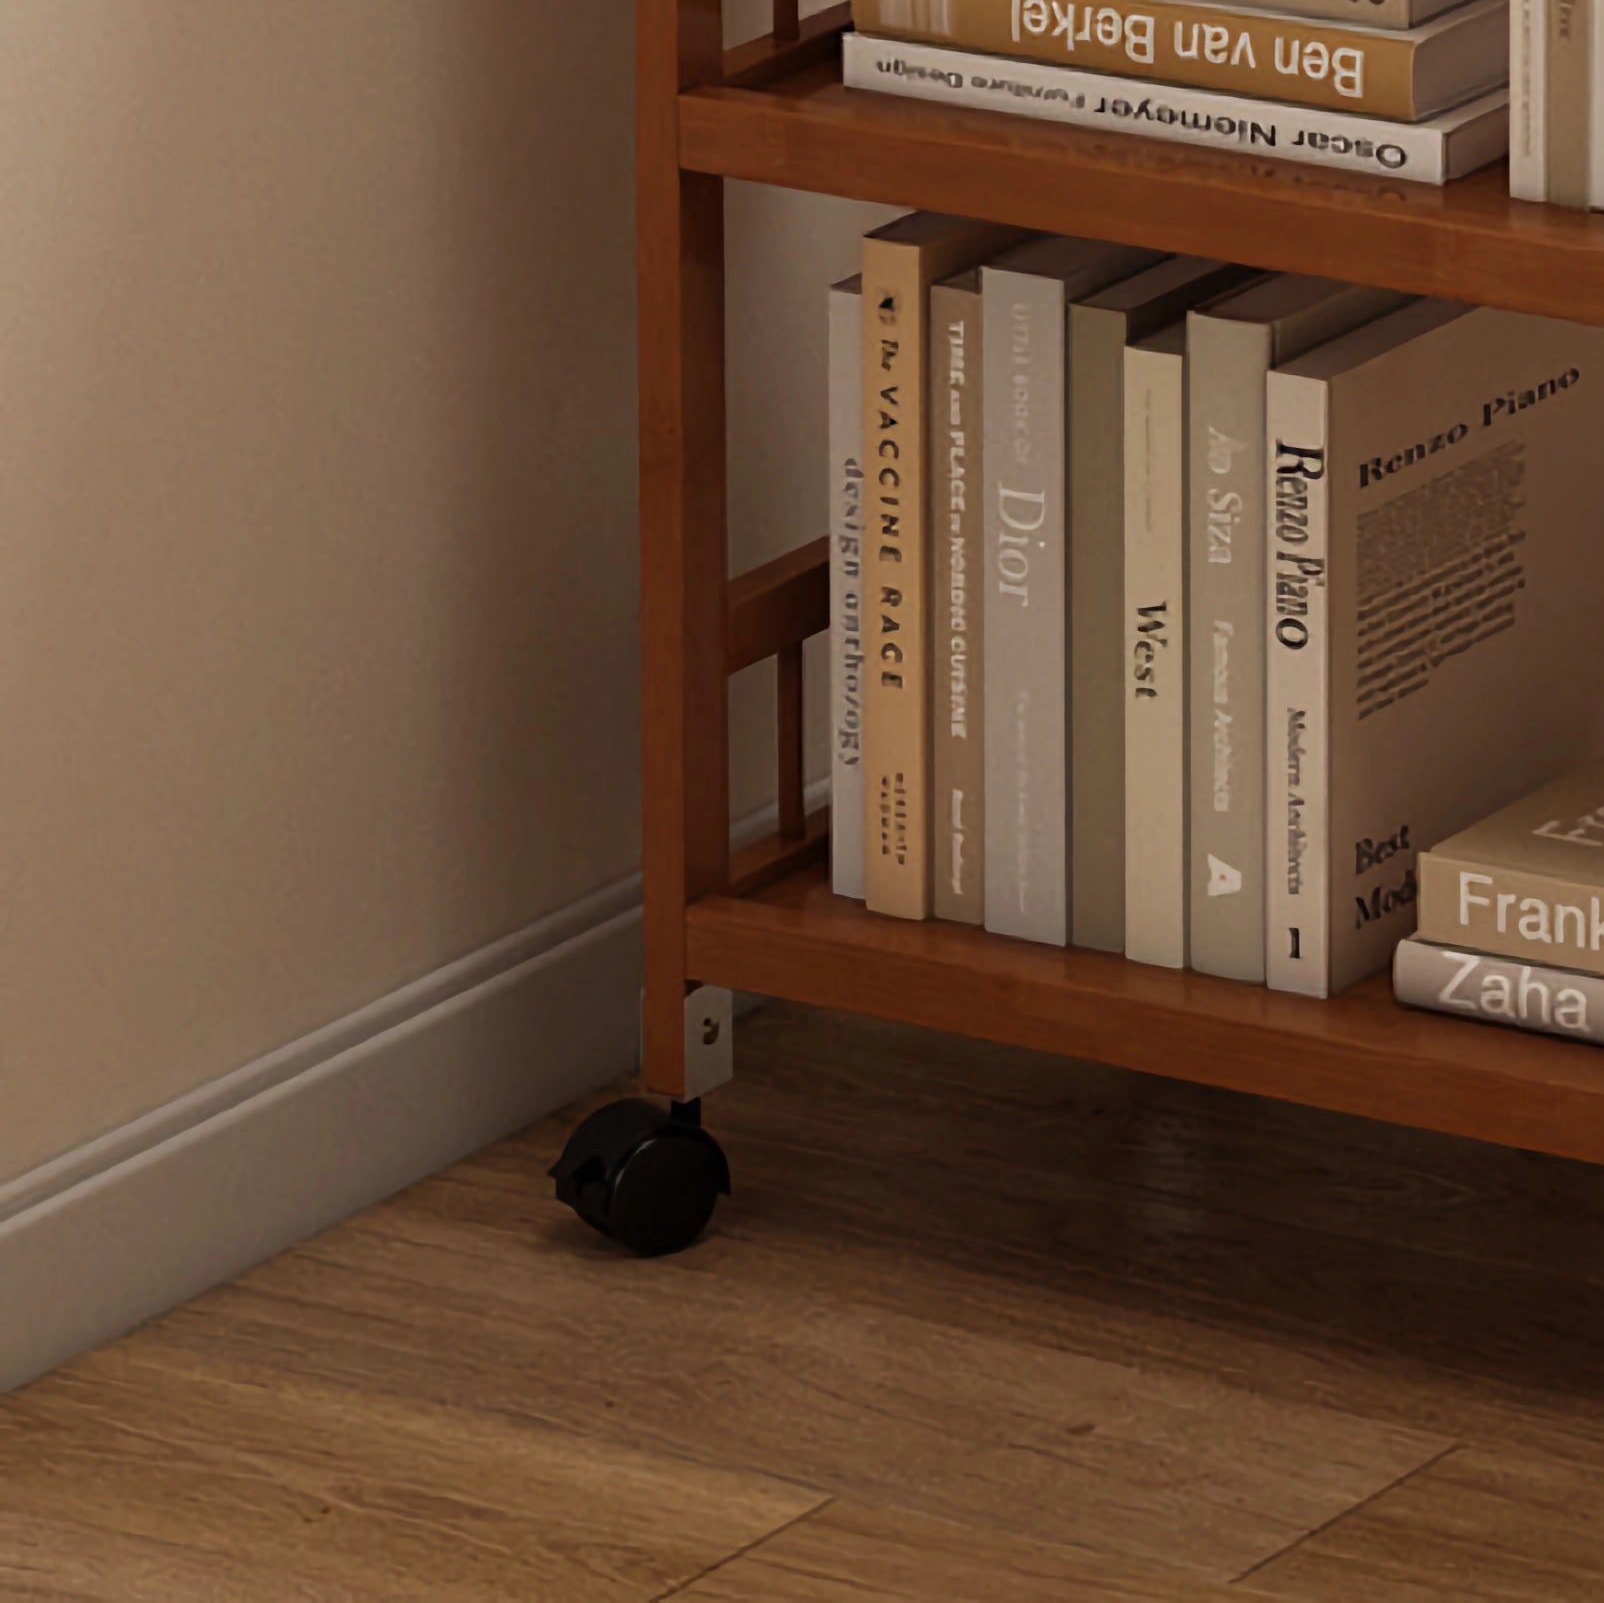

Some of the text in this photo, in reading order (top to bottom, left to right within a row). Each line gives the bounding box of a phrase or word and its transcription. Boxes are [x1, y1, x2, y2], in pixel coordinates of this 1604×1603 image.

[1173, 23, 1257, 70] van
[1273, 40, 1366, 98] Ben
[1094, 95, 1278, 147] Niemeyer
[1291, 130, 1408, 170] Oscar
[878, 385, 902, 564] VACCINE
[948, 430, 966, 512] PLACE
[1358, 366, 1581, 490] Renzo Piano
[999, 480, 1046, 608] Dior
[1274, 437, 1326, 652] Renzo Piano
[880, 586, 904, 691] RACE
[1133, 600, 1169, 702] West
[1436, 948, 1591, 1033] Zaha
